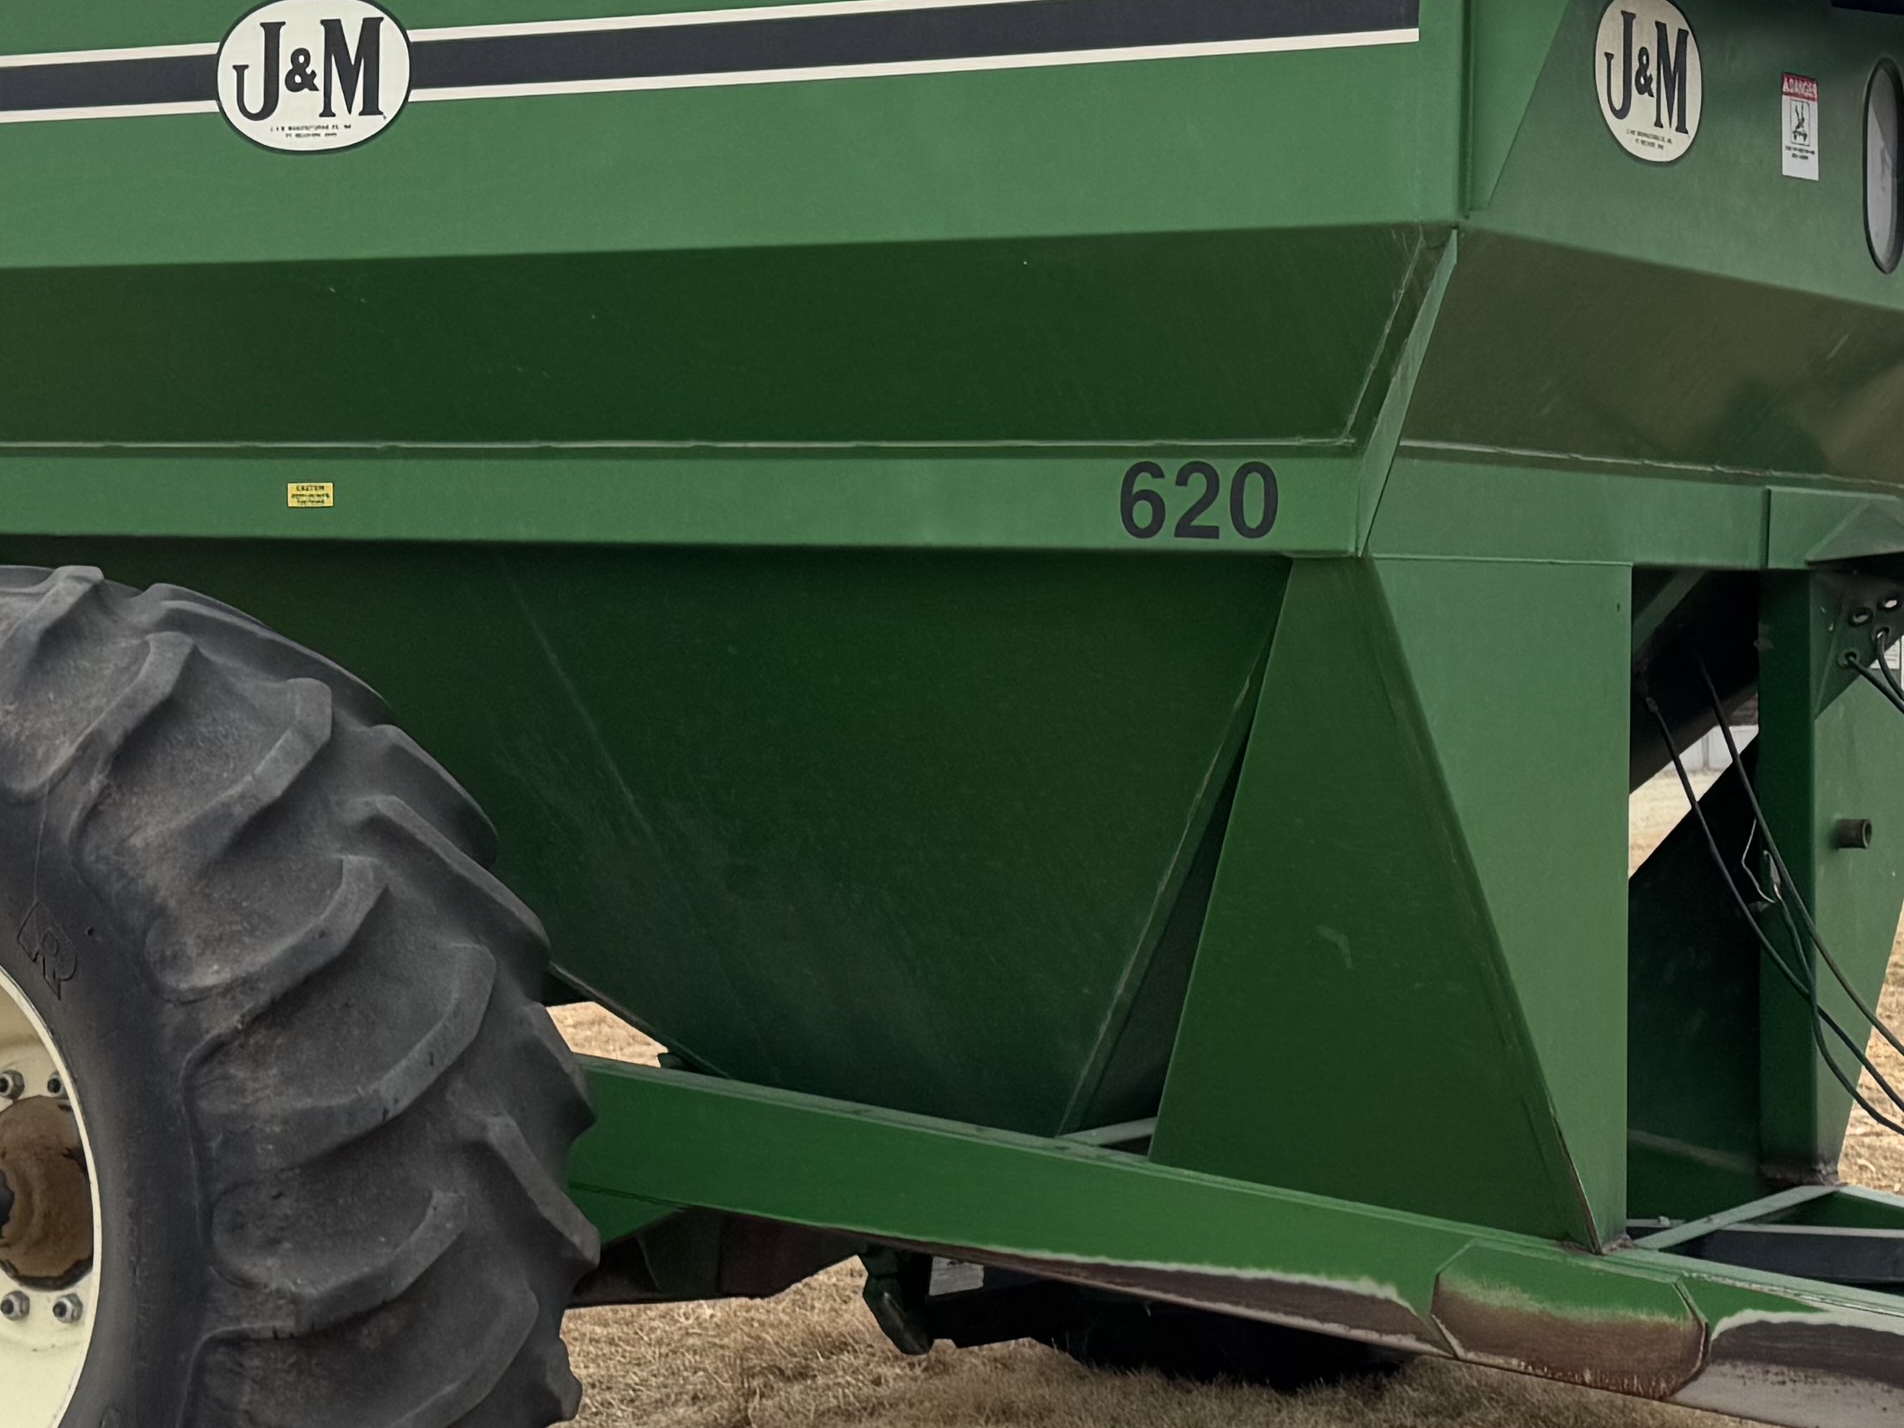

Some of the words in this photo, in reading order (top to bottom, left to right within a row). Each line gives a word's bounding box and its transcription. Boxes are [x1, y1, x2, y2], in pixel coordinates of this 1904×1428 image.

[232, 16, 385, 122] J&M
[1604, 9, 1690, 135] J&M
[1120, 460, 1279, 540] 620
